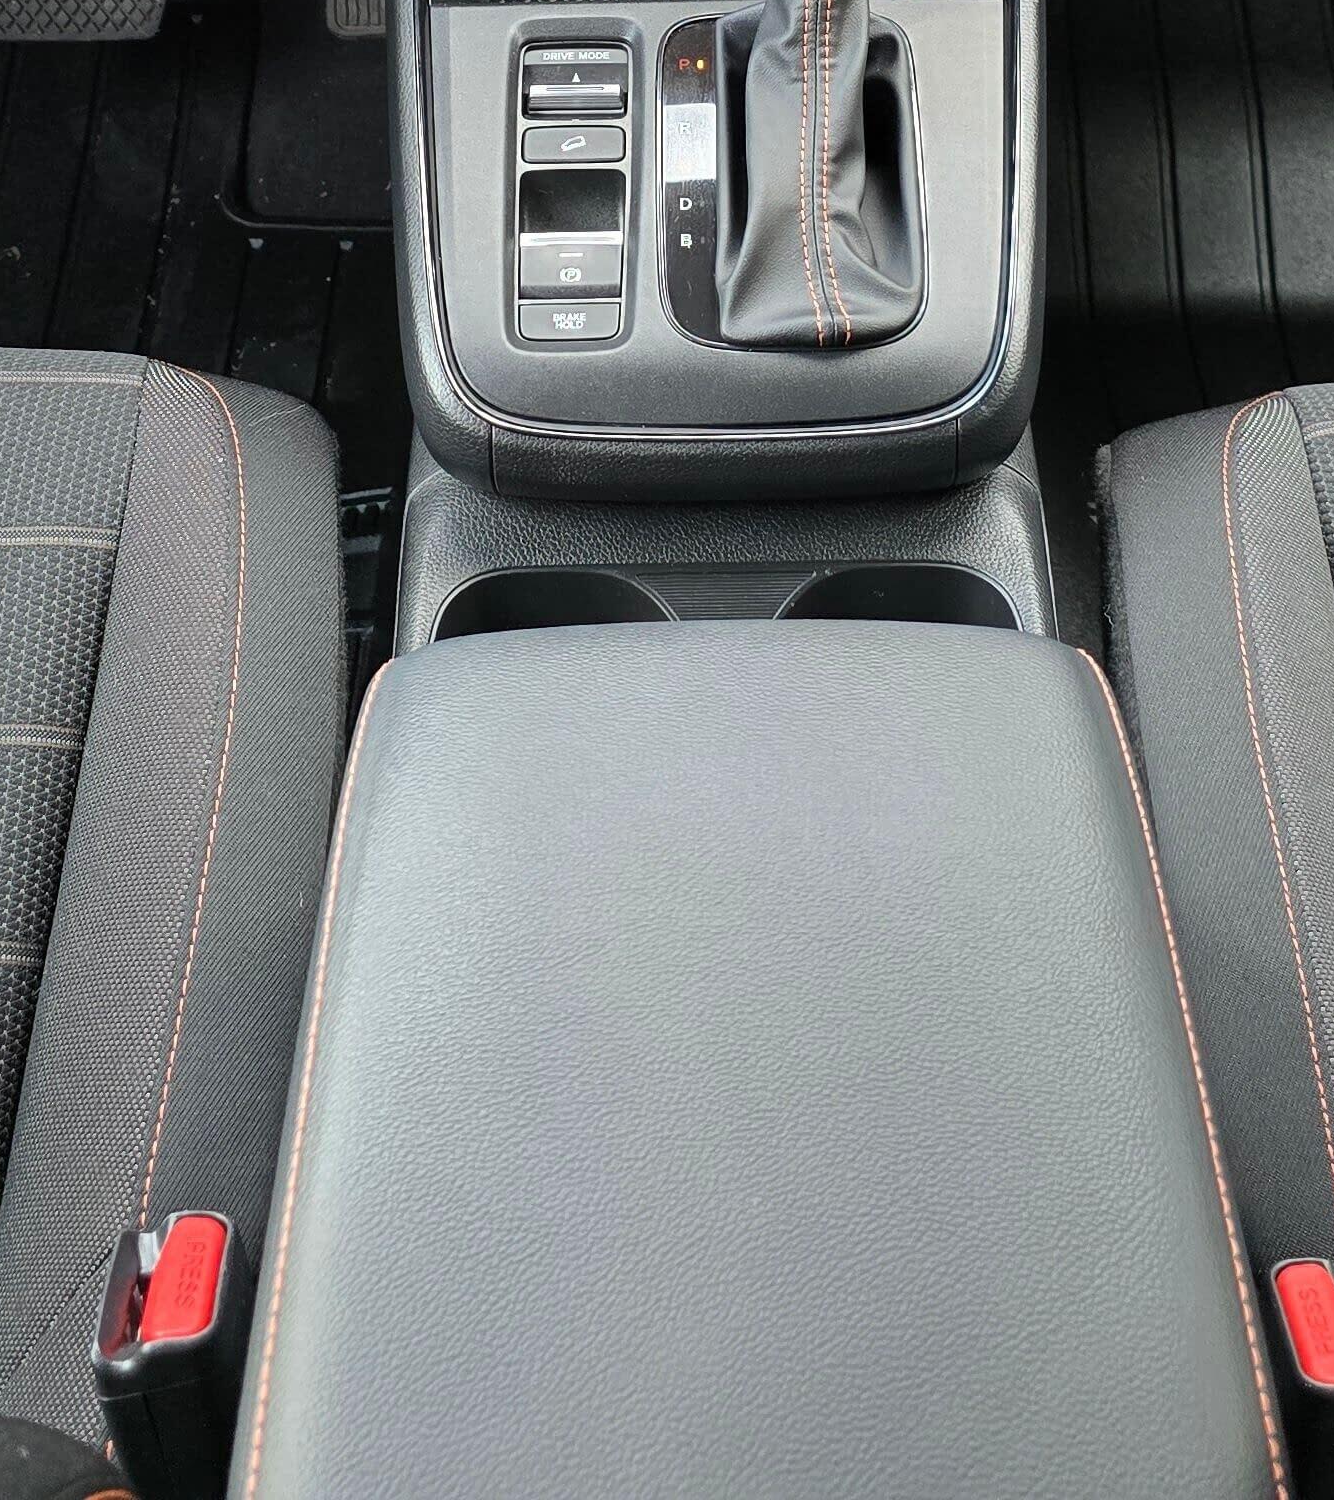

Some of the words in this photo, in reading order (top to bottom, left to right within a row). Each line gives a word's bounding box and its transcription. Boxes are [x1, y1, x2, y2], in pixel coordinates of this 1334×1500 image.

[542, 51, 575, 61] DRIVE
[578, 51, 610, 60] MODE
[678, 59, 690, 70] P
[679, 197, 692, 211] D
[680, 234, 693, 249] B
[552, 312, 586, 322] BRAKE
[555, 320, 584, 330] HOLD
[174, 1236, 207, 1310] PRESS
